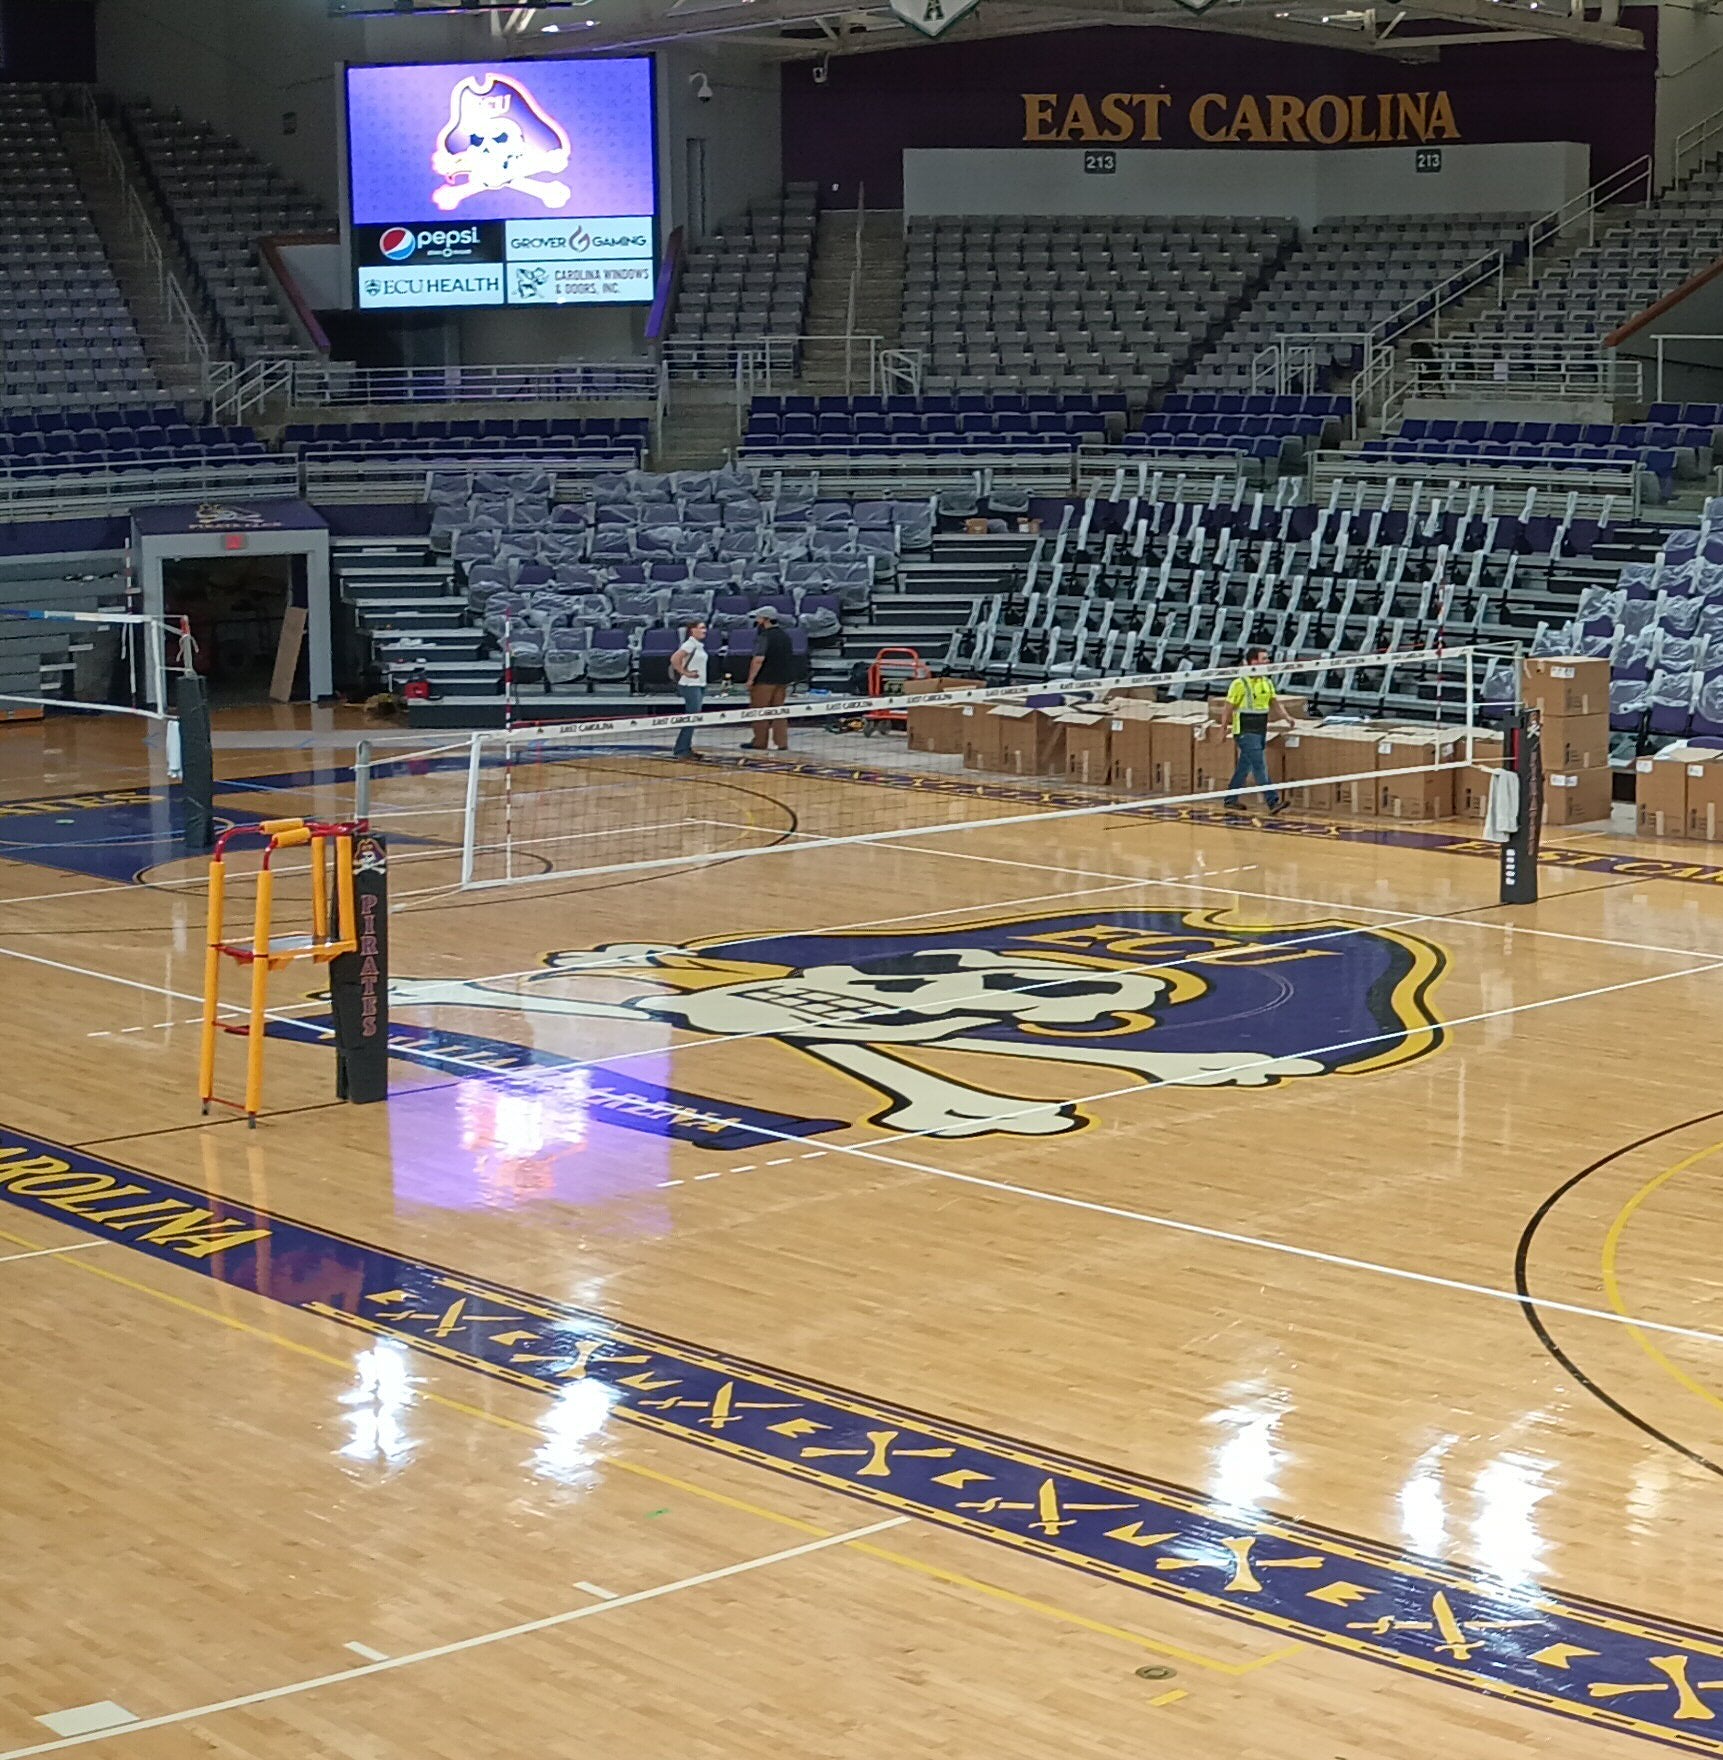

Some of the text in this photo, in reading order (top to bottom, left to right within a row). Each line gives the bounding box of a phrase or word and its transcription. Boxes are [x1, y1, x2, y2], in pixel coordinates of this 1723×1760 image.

[1022, 91, 1461, 144] EAST CAROLINA
[1085, 156, 1115, 170] 213
[1416, 154, 1440, 168] 213
[417, 227, 480, 249] pepsi
[511, 235, 647, 249] GROVER GAMING
[383, 277, 500, 295] ECU HEALTH
[554, 269, 601, 281] CAROLINA
[1440, 840, 1615, 867] EST
[1005, 924, 1344, 967] ECU
[359, 894, 380, 1037] PIRATES
[0, 1147, 273, 1259] ROLINA
